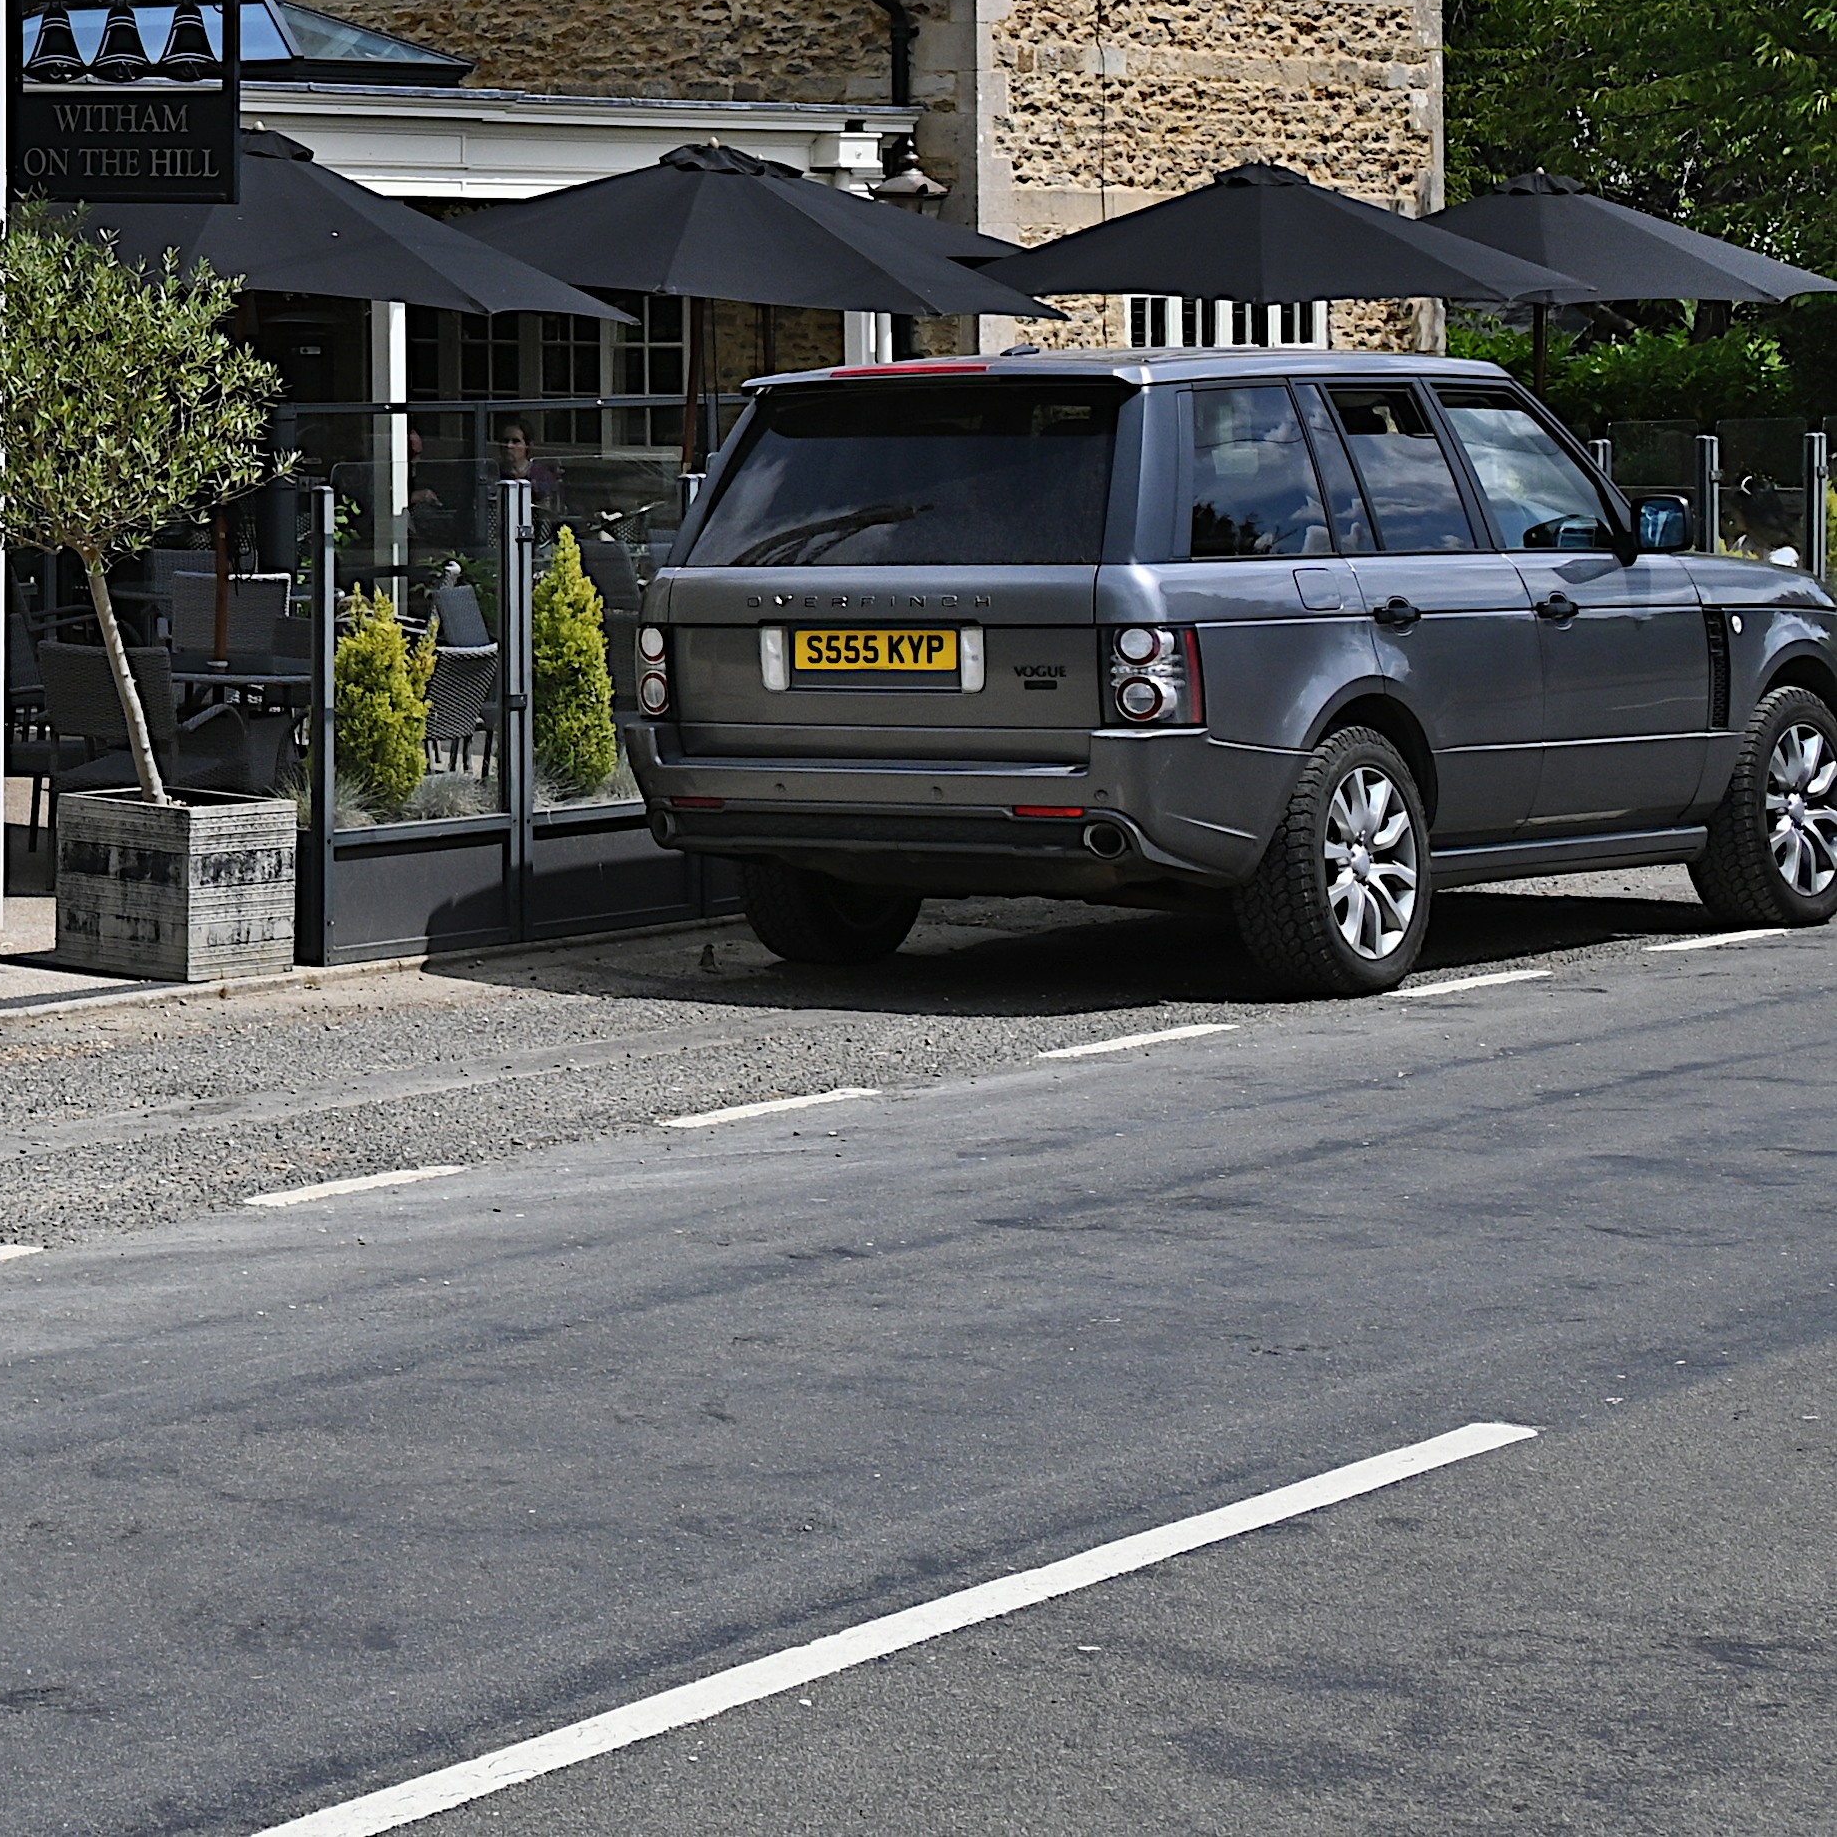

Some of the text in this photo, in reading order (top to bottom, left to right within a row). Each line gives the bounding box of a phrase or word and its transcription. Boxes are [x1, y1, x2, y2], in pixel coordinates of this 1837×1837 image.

[52, 104, 189, 133] WITHAM
[23, 147, 220, 178] ON THE HILL
[747, 594, 991, 609] OVERFINCH
[806, 634, 944, 664] S555 KYP
[1013, 665, 1067, 678] VOGUE
